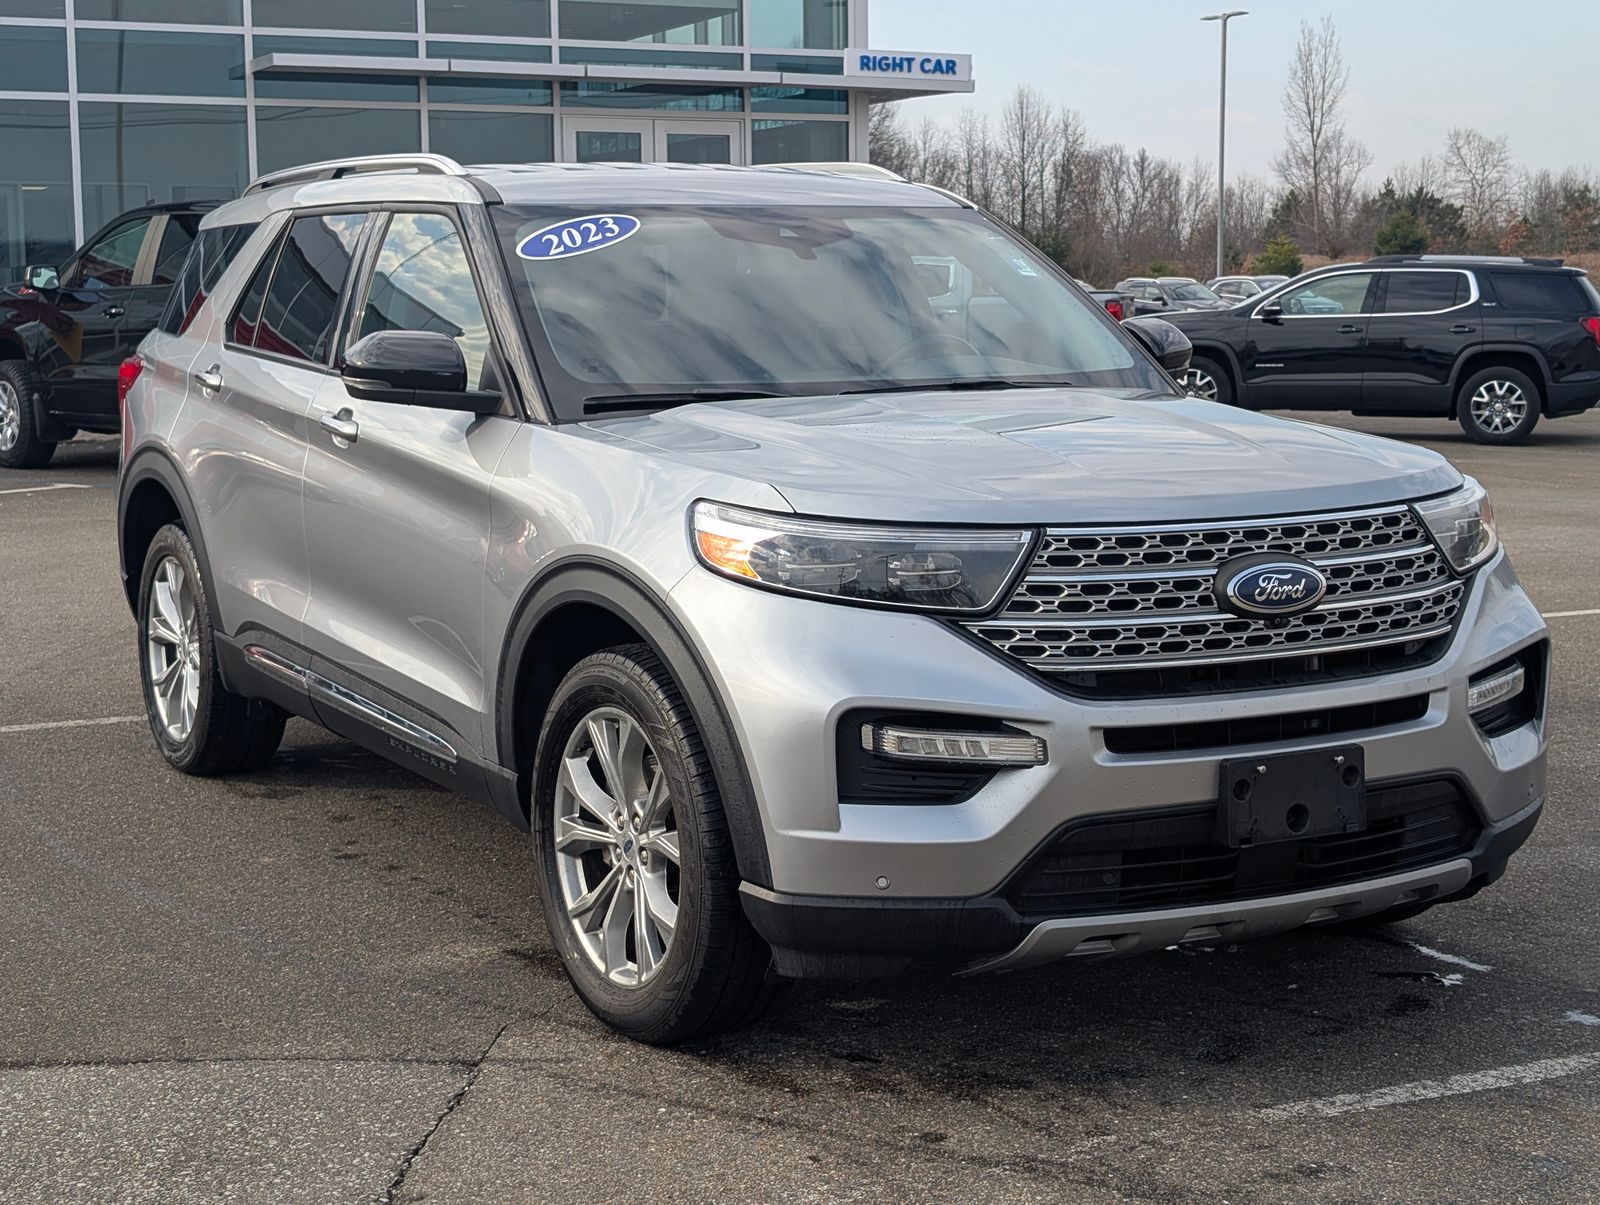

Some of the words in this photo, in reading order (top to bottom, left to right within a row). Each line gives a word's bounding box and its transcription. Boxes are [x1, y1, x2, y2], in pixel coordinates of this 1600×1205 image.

[859, 55, 915, 73] RIGHT
[920, 58, 957, 75] CAR
[541, 217, 620, 256] 2023
[1254, 573, 1306, 602] Ford
